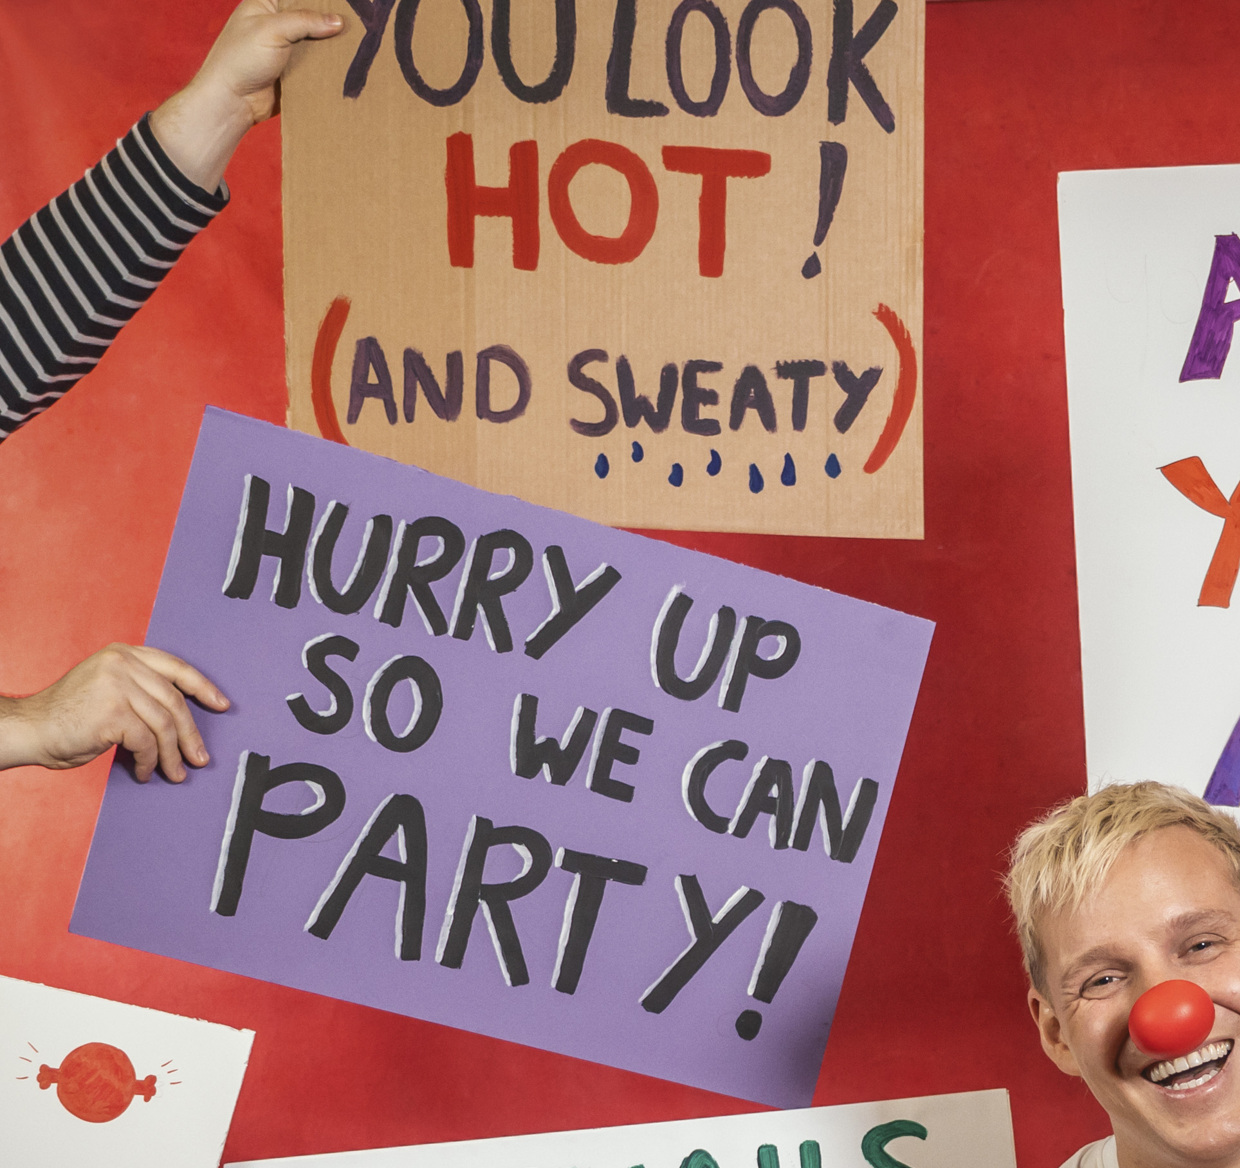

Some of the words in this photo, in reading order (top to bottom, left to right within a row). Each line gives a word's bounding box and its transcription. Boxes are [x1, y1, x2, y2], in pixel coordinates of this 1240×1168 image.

[342, 0, 577, 107] YOU
[605, 0, 899, 134] LOOK
[311, 295, 532, 446] (AND
[567, 303, 918, 475] SWEATY)
[222, 473, 622, 660] HURRY
[651, 584, 802, 713] UP
[285, 632, 443, 753] SO
[510, 693, 655, 803] WE
[682, 739, 880, 864] CAN
[210, 749, 818, 1042] PARTY!
